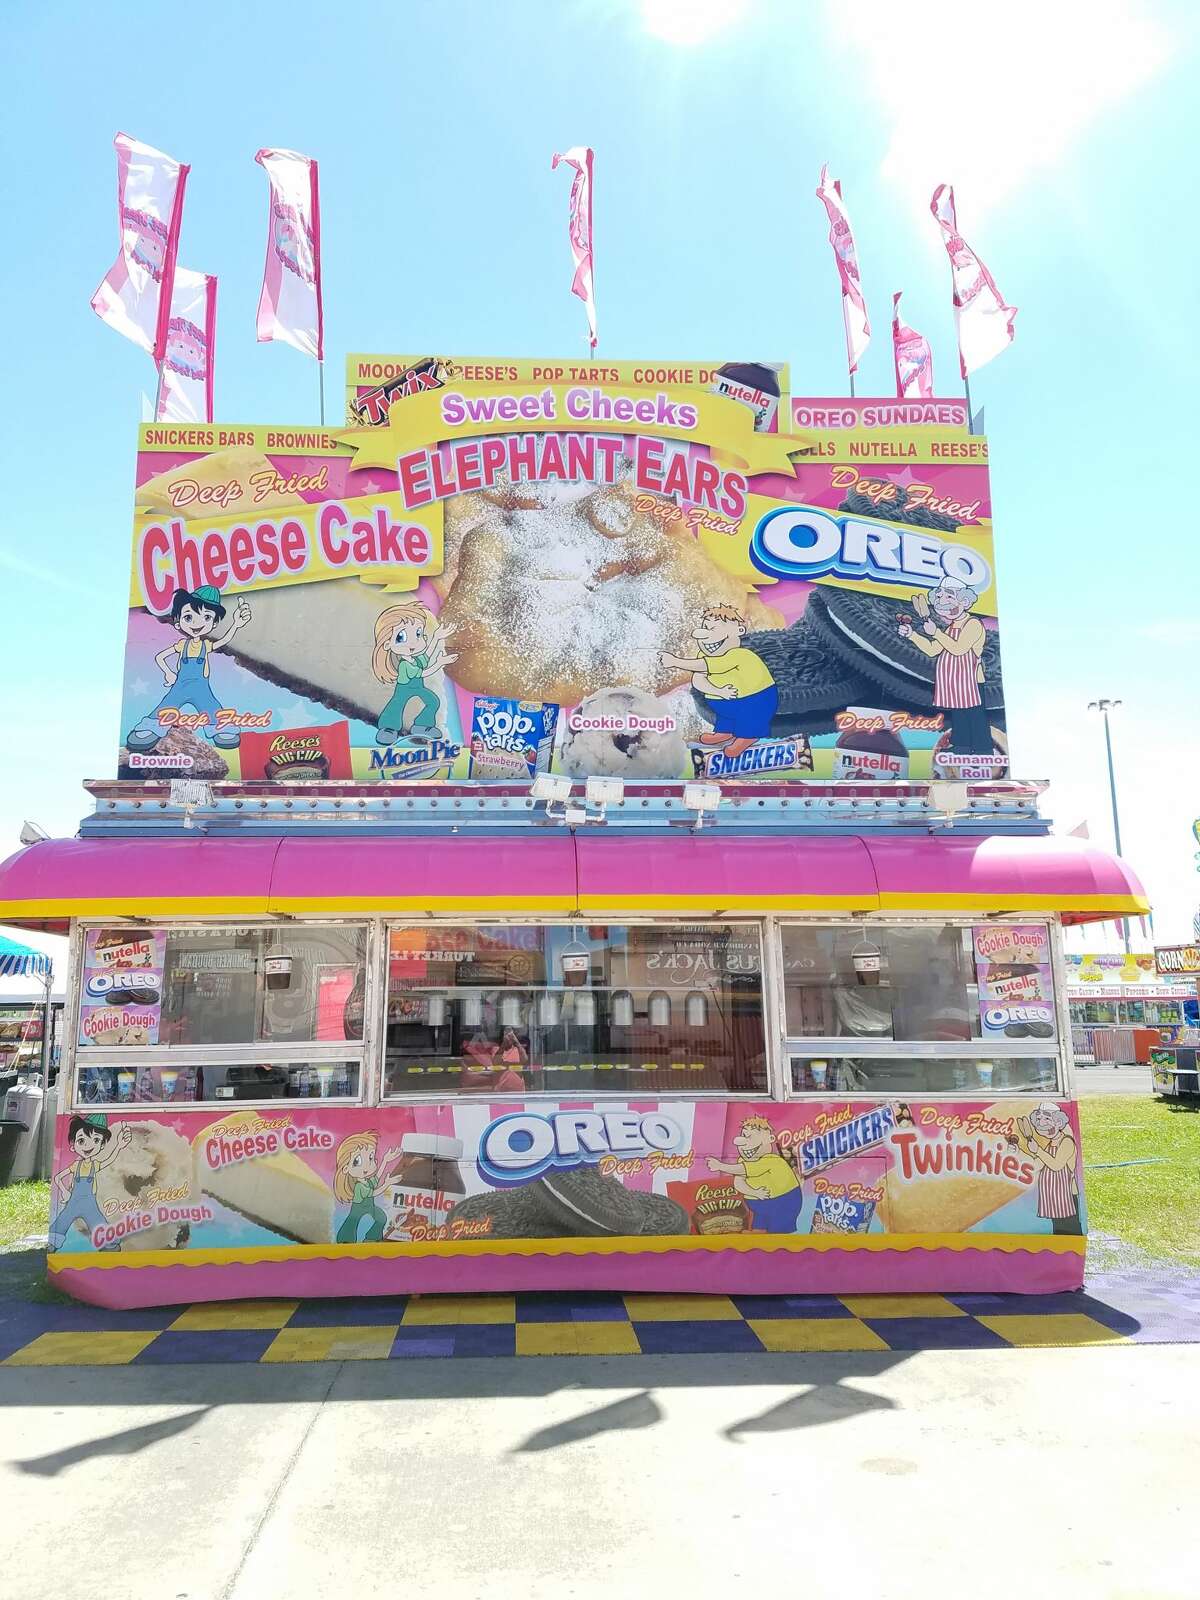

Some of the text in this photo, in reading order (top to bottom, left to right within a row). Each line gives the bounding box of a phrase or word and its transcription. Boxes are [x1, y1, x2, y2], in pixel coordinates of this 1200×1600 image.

[532, 368, 619, 382] POP TARTS
[633, 368, 694, 384] COOKIE
[719, 380, 771, 408] nutella
[441, 387, 698, 429] Sweet Cheeks
[796, 406, 965, 427] OREO SUNDAES
[145, 431, 255, 446] SNICKERS BARS
[849, 442, 917, 457] NUTELLA
[931, 443, 988, 457] REESE'S
[168, 466, 328, 508] Deep Fried
[400, 434, 748, 519] ELEPHANT EARS
[831, 465, 981, 522] Deep Fried
[634, 494, 741, 536] Deep Fried
[142, 504, 430, 612] Cheese Cake
[755, 507, 988, 588] OREO
[158, 708, 273, 730] Deep Fried
[571, 716, 623, 730] Cookie
[629, 716, 675, 732] Dough
[835, 711, 945, 732] Deep Fried
[270, 735, 321, 752] Reese's
[131, 754, 193, 767] Brownie
[271, 749, 323, 765] BIG CUP
[477, 753, 525, 772] Strawberry
[709, 743, 796, 776] SNICKERS
[842, 754, 901, 772] nutella
[962, 768, 991, 778] Roll
[103, 942, 150, 961] nutella
[976, 931, 1044, 956] Cookie Dough
[1158, 951, 1184, 969] CORN
[87, 971, 161, 994] OREO
[995, 975, 1038, 994] nutella
[83, 1011, 156, 1037] Cookie Dough
[984, 1006, 1052, 1026] OREO
[212, 1115, 294, 1140] Deep Fried
[778, 1104, 853, 1148] Deep Fried
[920, 1107, 1014, 1136] Deep Fried
[206, 1127, 332, 1169] Cheese Cake
[480, 1111, 686, 1175] OREO
[801, 1106, 894, 1171] SNICKERS
[600, 1150, 695, 1177] Deep Fried
[890, 1132, 1036, 1186] Twinkies
[103, 1181, 191, 1217] Deep Fried
[393, 1190, 456, 1212] nutella
[696, 1184, 738, 1201] Reeses
[814, 1177, 885, 1202] Deep Fried
[697, 1199, 742, 1215] BIG CUP
[94, 1206, 212, 1248] Cookie Dough
[410, 1216, 490, 1242] Deep Fried
